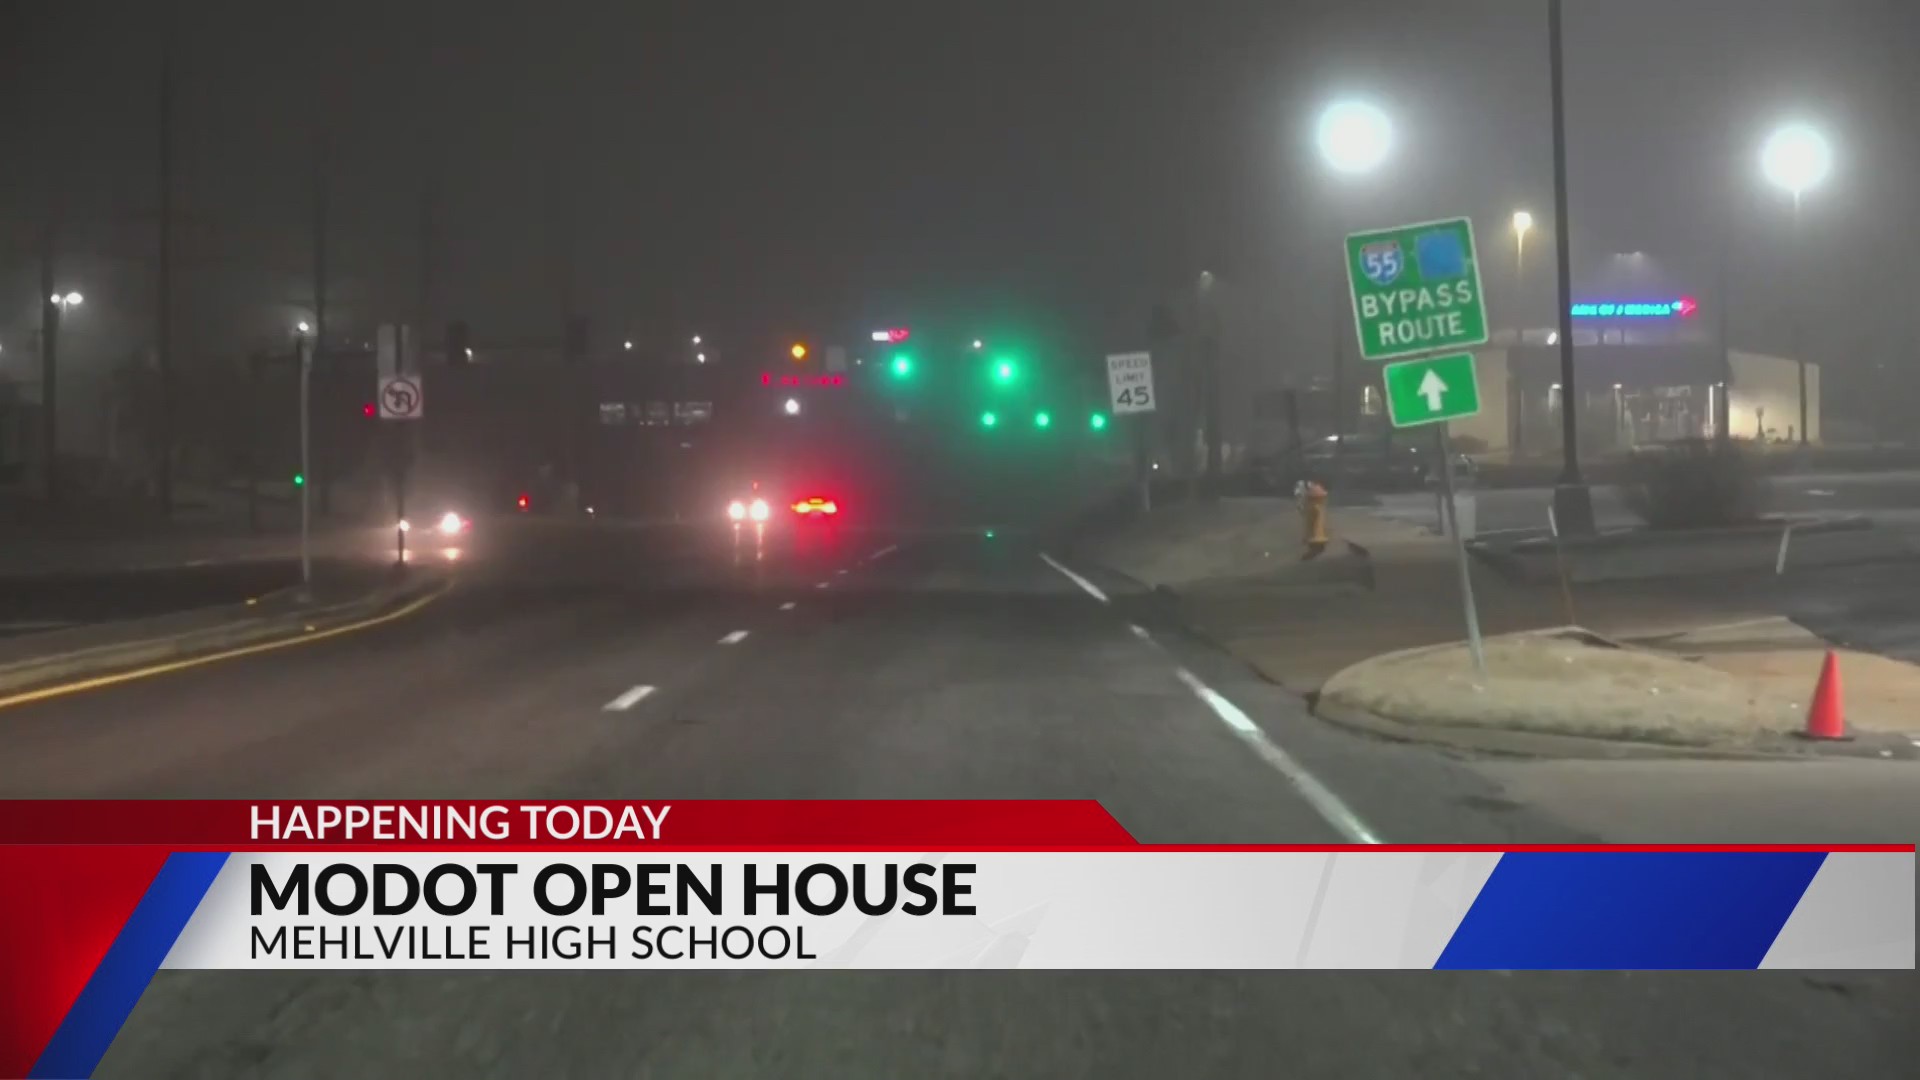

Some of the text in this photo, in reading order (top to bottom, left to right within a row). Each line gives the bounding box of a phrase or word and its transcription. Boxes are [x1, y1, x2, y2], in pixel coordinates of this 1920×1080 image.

[1366, 251, 1398, 278] 55
[1361, 279, 1473, 318] BYPASS
[1378, 311, 1467, 346] ROUTE
[1110, 358, 1149, 370] SPEED
[1115, 371, 1145, 385] LIMIT
[1116, 385, 1150, 407] 45
